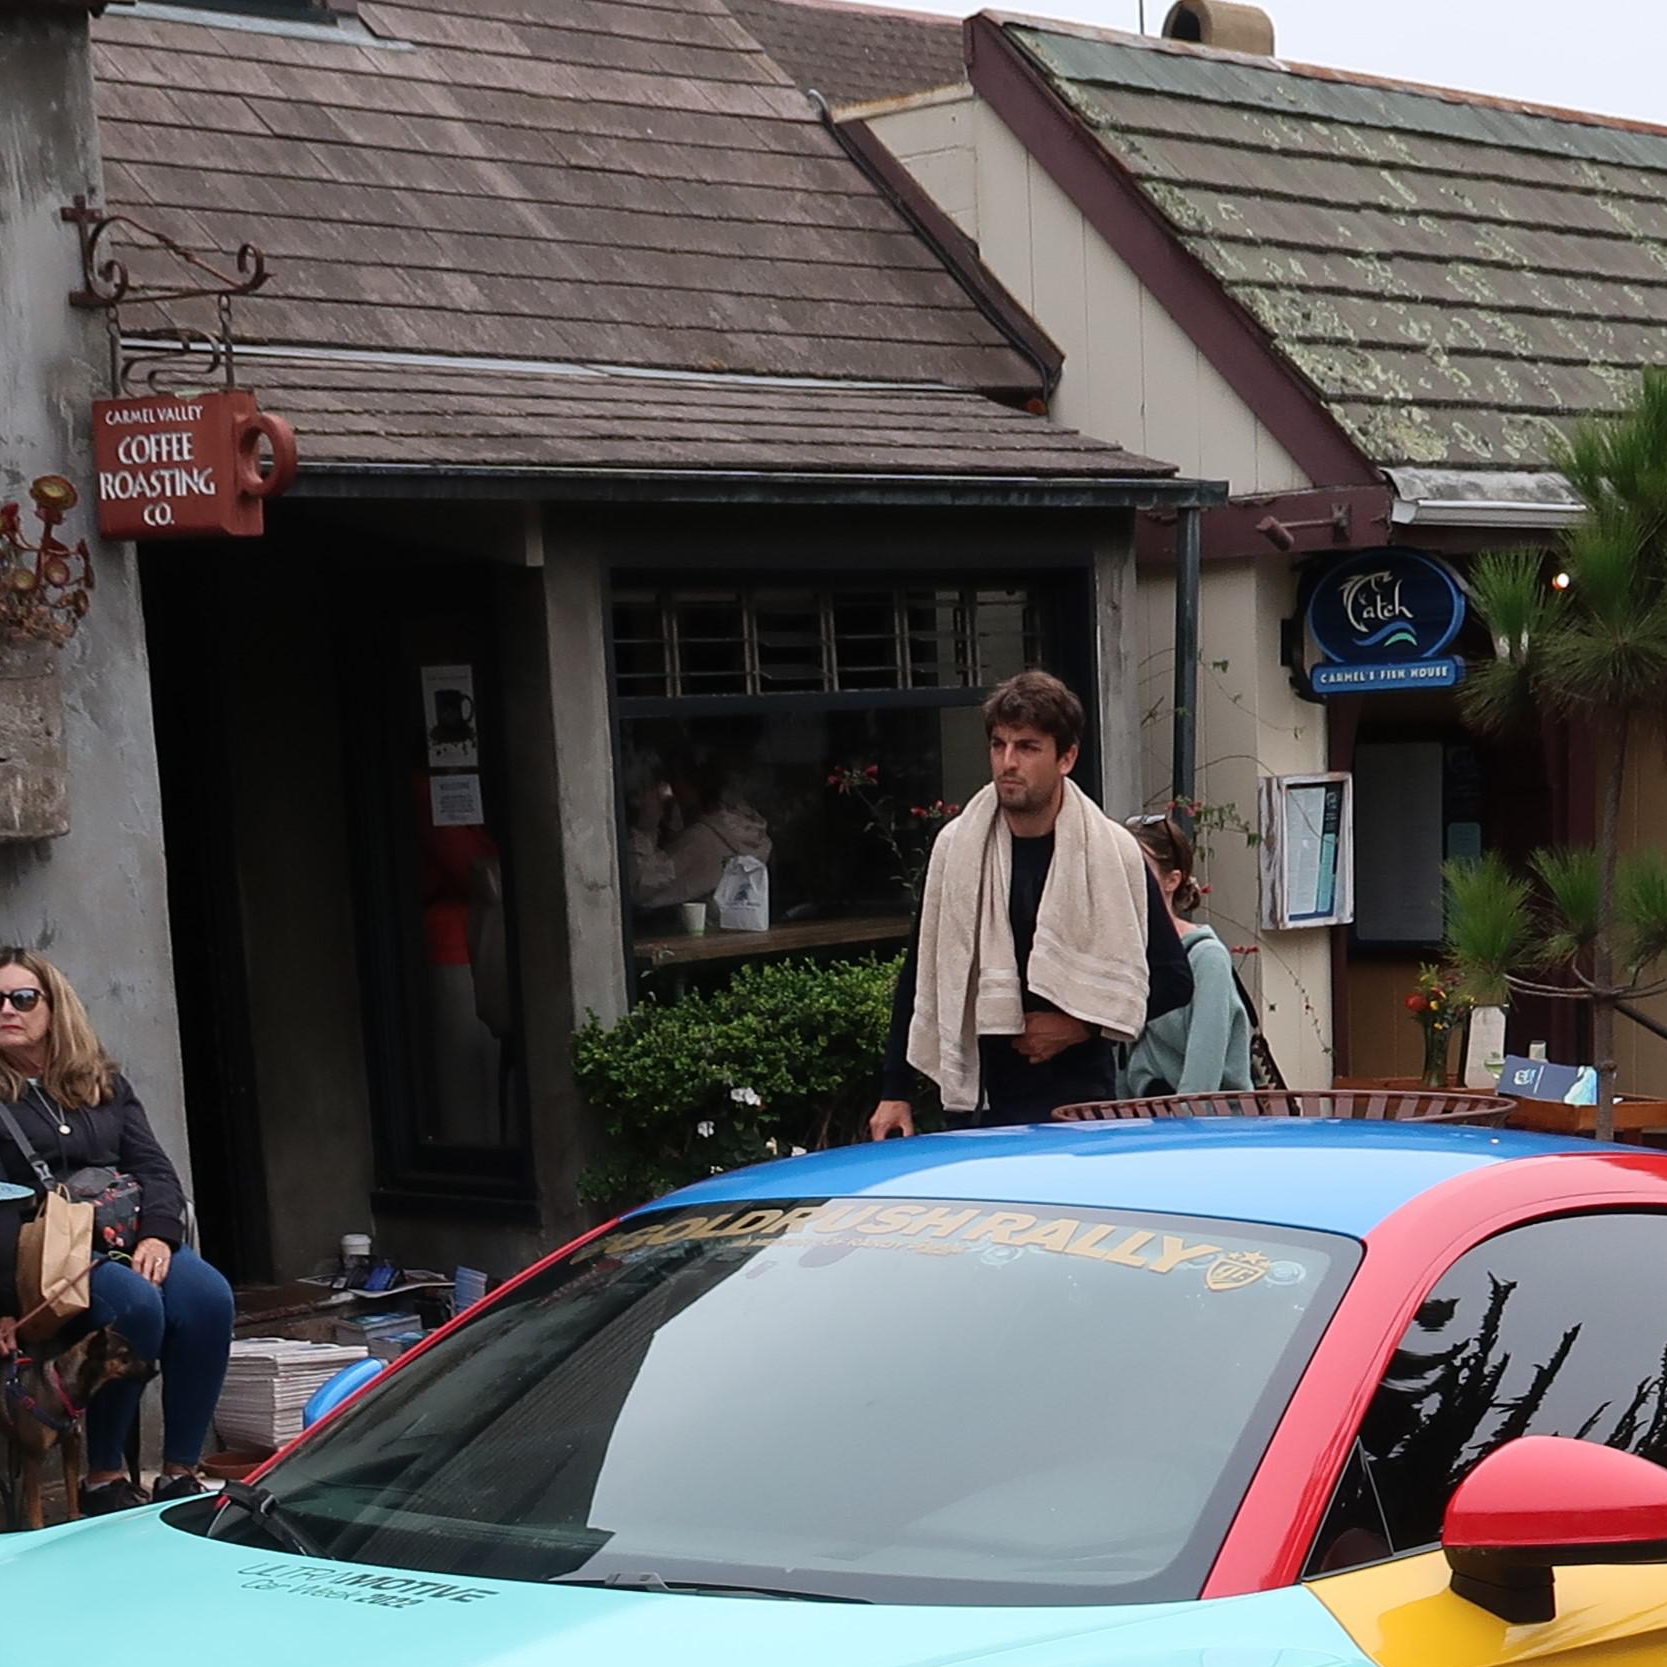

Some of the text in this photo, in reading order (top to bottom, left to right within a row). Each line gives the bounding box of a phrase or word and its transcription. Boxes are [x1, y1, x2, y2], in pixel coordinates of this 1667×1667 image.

[105, 405, 203, 426] CARMEL VALLEY
[117, 432, 194, 465] COFFEE
[100, 468, 215, 500] ROASTING
[143, 501, 175, 527] CO.
[1339, 570, 1414, 633] Catch
[1320, 666, 1448, 685] CARMEL'S FISH HOUSE
[604, 1205, 1222, 1274] GOLDRUSH RALLY
[238, 1562, 500, 1603] ULTRAMOTIVE
[241, 1579, 290, 1591] Car
[352, 1593, 425, 1609] 2022
